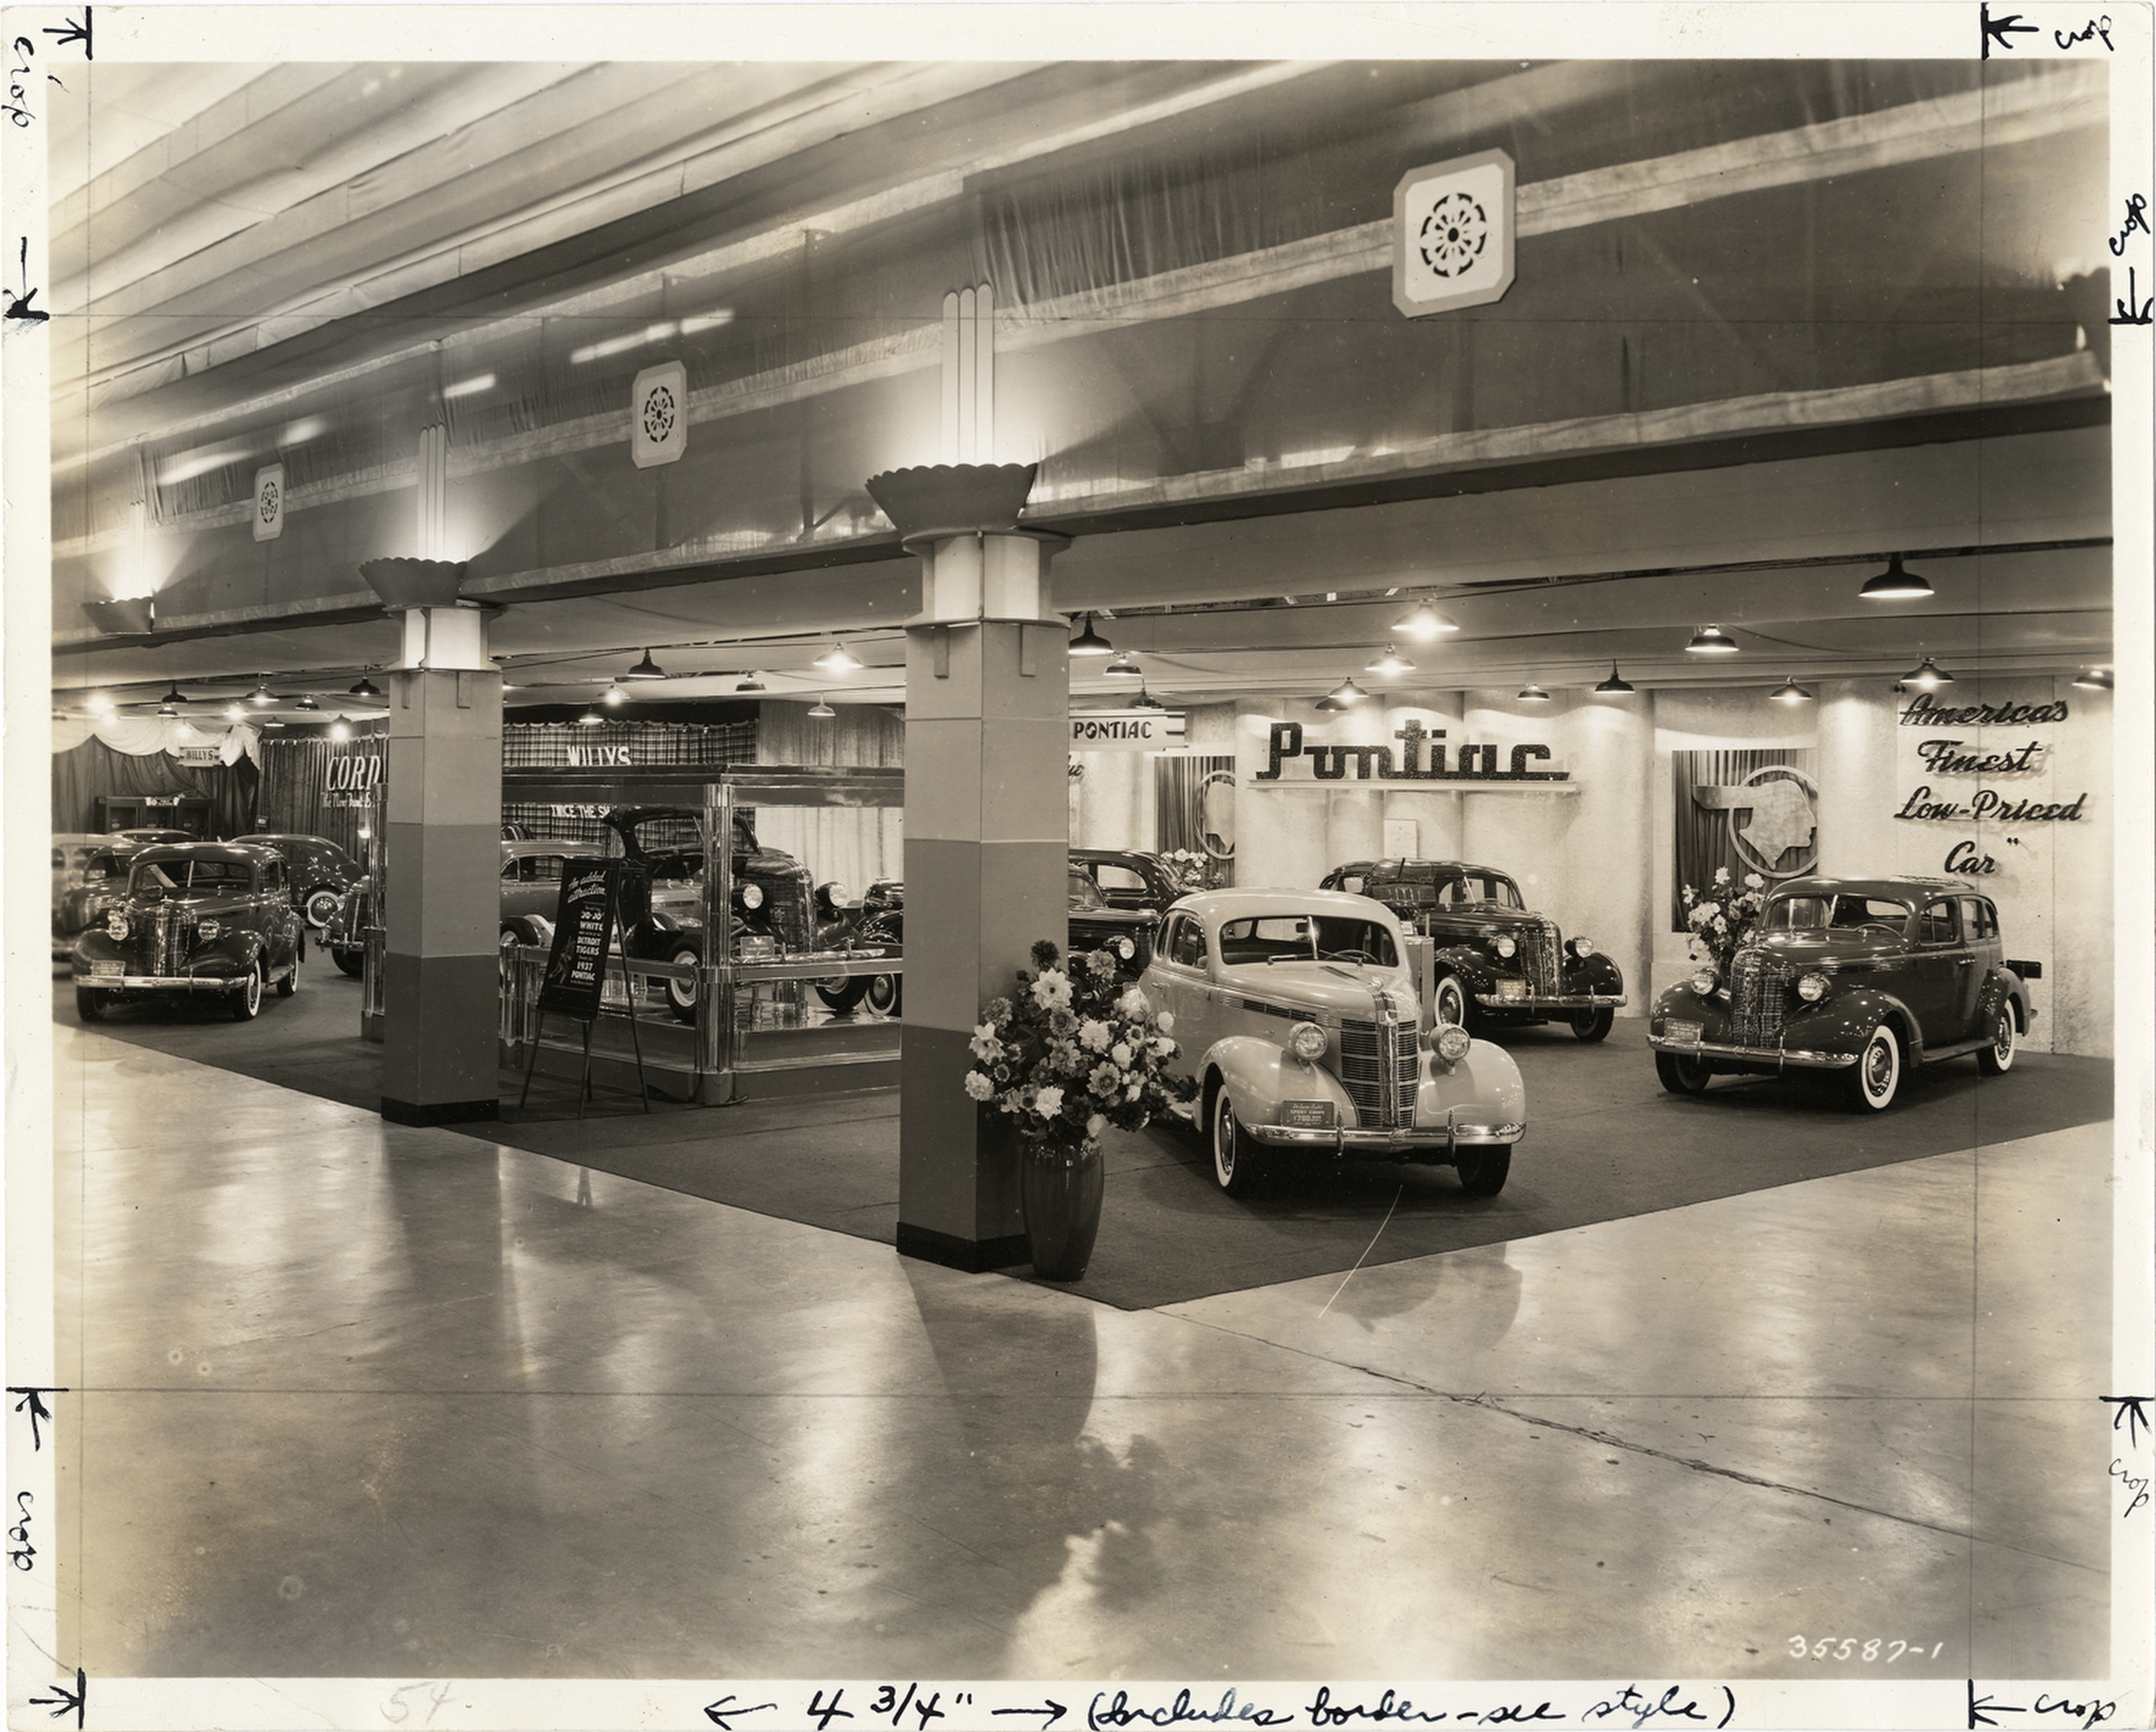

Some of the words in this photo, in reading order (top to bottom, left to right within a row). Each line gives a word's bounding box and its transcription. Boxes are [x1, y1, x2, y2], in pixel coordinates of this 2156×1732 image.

[1, 36, 35, 128] crop
[2109, 193, 2151, 257] crop
[1073, 721, 1152, 740] PONTIAC
[185, 750, 213, 761] WILLYS
[567, 745, 632, 766] WILLYS
[1256, 719, 1570, 780] Pontiac
[1917, 739, 2044, 773] Finest
[327, 755, 381, 791] CORD
[577, 804, 597, 819] THE
[1893, 786, 2088, 821] Low-Priced
[577, 936, 602, 946] DETROIT
[579, 921, 604, 931] WHITE
[576, 945, 599, 956] TIGERS
[577, 962, 594, 971] 1937
[571, 969, 596, 981] PONTIAC
[2108, 1458, 2150, 1519] crop
[8, 1491, 37, 1572] crop
[806, 1689, 855, 1731] 4
[2034, 1694, 2116, 1731] crop
